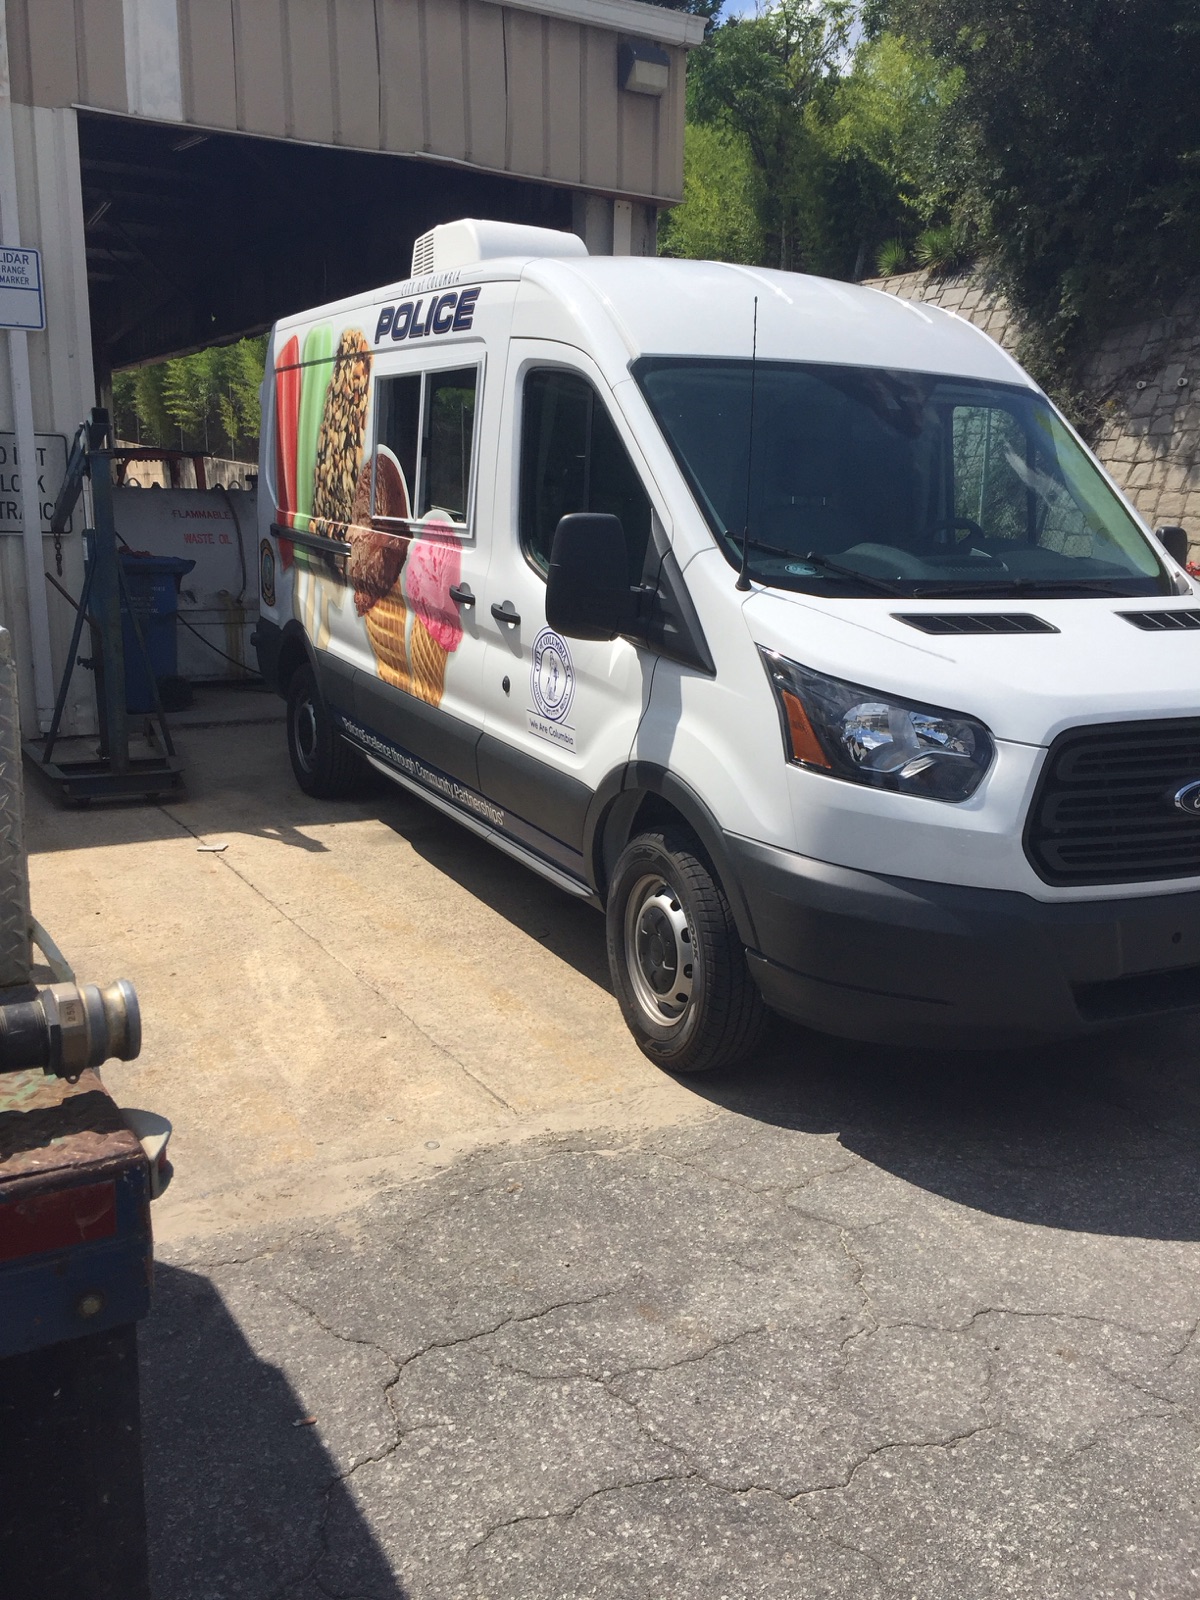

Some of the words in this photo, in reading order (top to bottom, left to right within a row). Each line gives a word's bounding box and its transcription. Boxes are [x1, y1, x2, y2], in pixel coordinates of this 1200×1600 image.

[2, 265, 26, 275] RANGE
[374, 287, 481, 344] POLICE
[172, 510, 231, 519] FLAMMABLE
[184, 533, 215, 544] WASTE
[218, 533, 233, 545] OIL
[529, 718, 539, 730] We
[539, 722, 548, 734] Are
[548, 726, 574, 746] Columbia
[391, 747, 416, 774] through
[416, 761, 454, 799] Community
